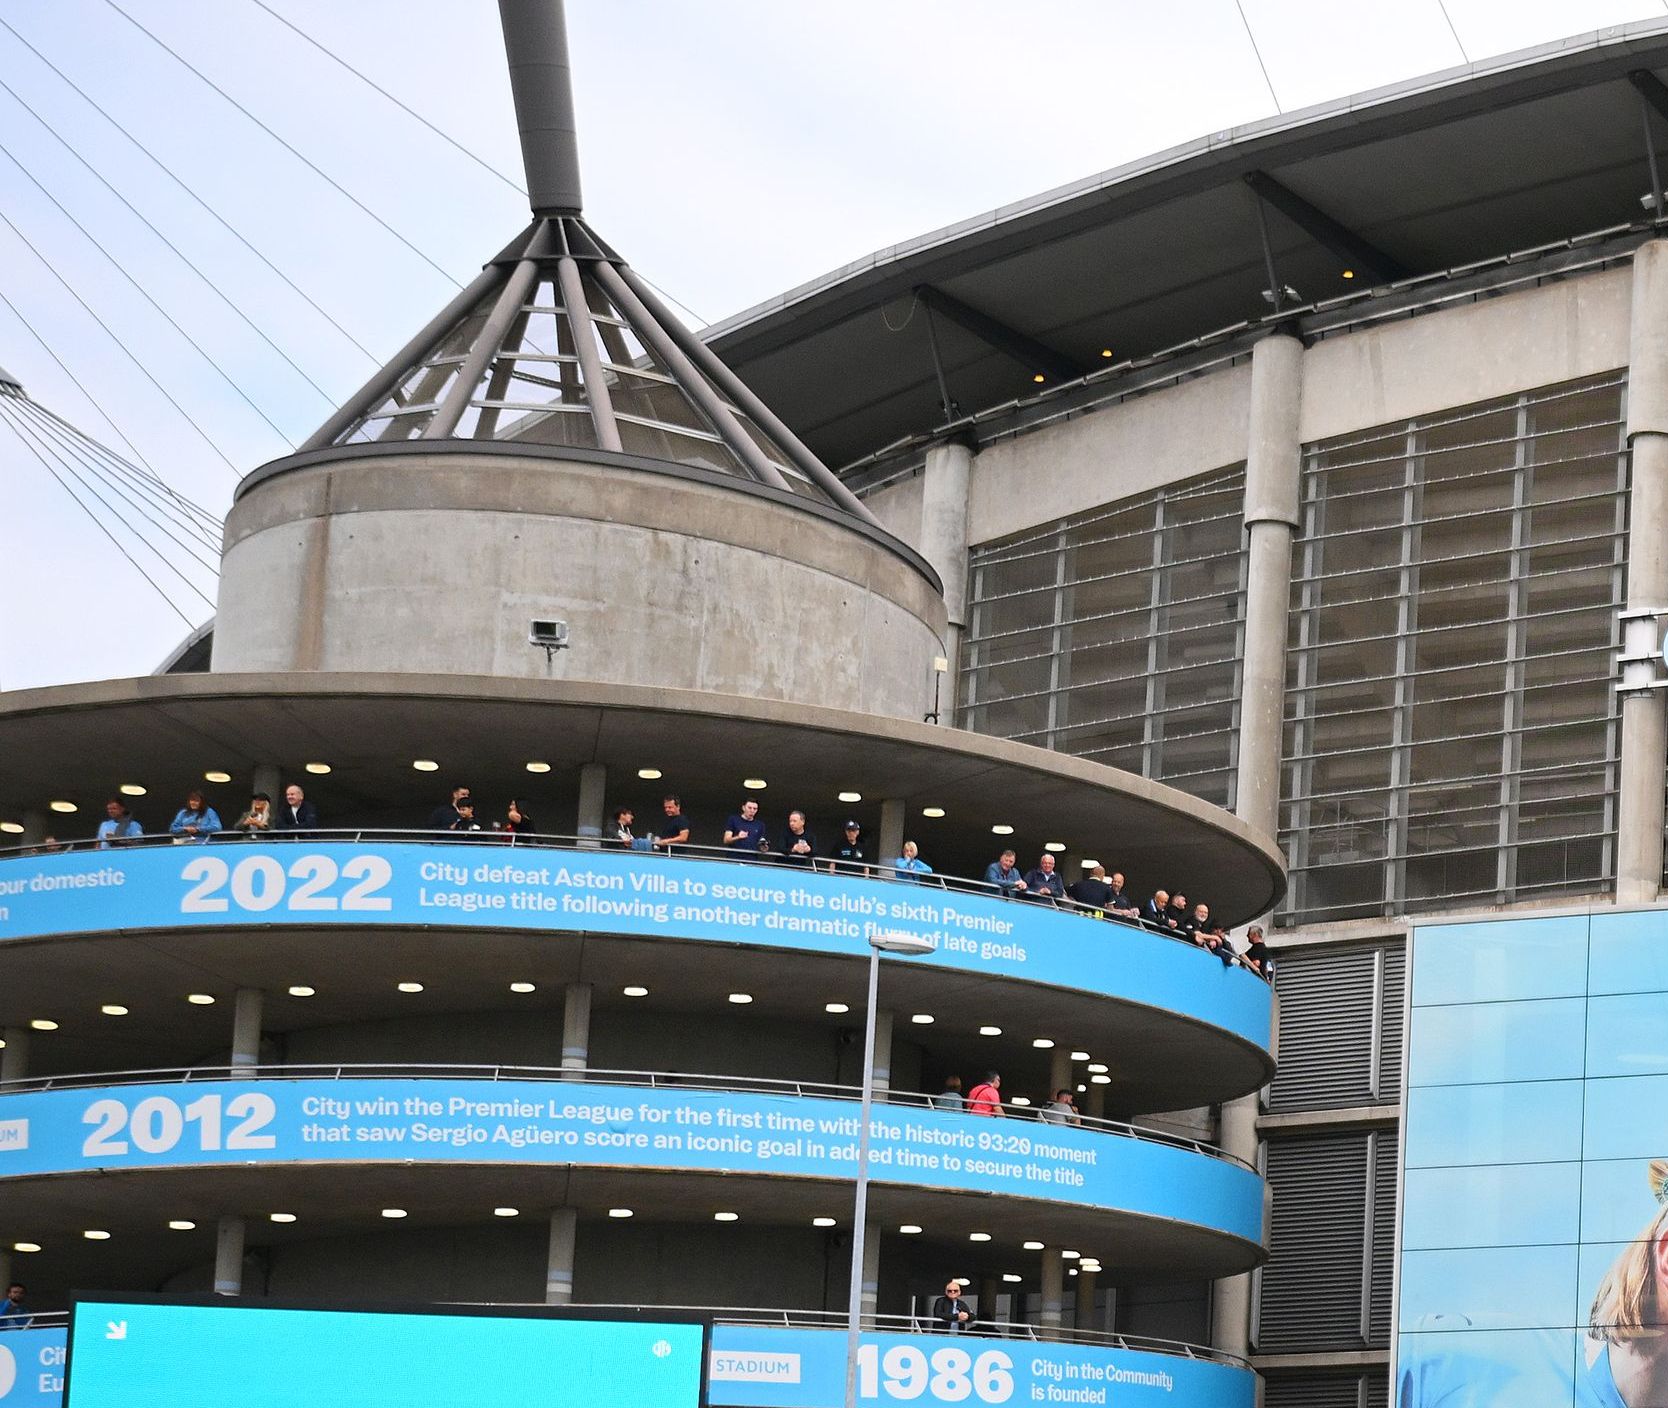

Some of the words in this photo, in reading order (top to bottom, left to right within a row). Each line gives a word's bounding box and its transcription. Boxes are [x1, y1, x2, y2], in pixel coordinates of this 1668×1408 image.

[182, 855, 392, 912] 2022
[421, 862, 468, 885] City
[474, 864, 549, 885] defeat
[555, 868, 623, 890] Aston
[630, 872, 678, 894] Villa
[712, 884, 786, 904] secure
[790, 889, 824, 908] the
[829, 894, 886, 916] club’s
[891, 902, 938, 923] sixth
[943, 908, 1013, 934] Premier
[420, 888, 506, 911] League
[510, 892, 557, 911] title
[562, 894, 669, 922] following
[674, 906, 760, 926] another
[765, 911, 859, 937] dramatic
[944, 932, 978, 953] late
[981, 942, 1026, 961] goals
[83, 1093, 276, 1156] 2012
[302, 1124, 350, 1141] that
[356, 1128, 406, 1141] saw
[412, 1123, 488, 1146] Sergio
[492, 1125, 578, 1147] Agüero
[584, 1132, 648, 1147] score
[688, 1132, 752, 1152] iconic
[757, 1140, 801, 1158] goal
[896, 1148, 939, 1168] time
[965, 1159, 1022, 1178] secure
[1026, 1164, 1051, 1182] the
[1054, 1168, 1083, 1186] title
[303, 1097, 350, 1120] City
[356, 1097, 399, 1115] win
[404, 1098, 443, 1115] the
[448, 1097, 544, 1117] Premier
[550, 1100, 633, 1124] League
[639, 1104, 671, 1122] for
[716, 1108, 762, 1128] first
[767, 1112, 815, 1132] time
[906, 1124, 974, 1148] historic
[978, 1132, 1030, 1154] 93:20
[1034, 1144, 1096, 1164] moment
[717, 1359, 790, 1374] STADIUM
[857, 1344, 1014, 1403] 1986
[1032, 1359, 1062, 1381] City
[1104, 1364, 1172, 1391] Community
[1048, 1384, 1105, 1404] founded
